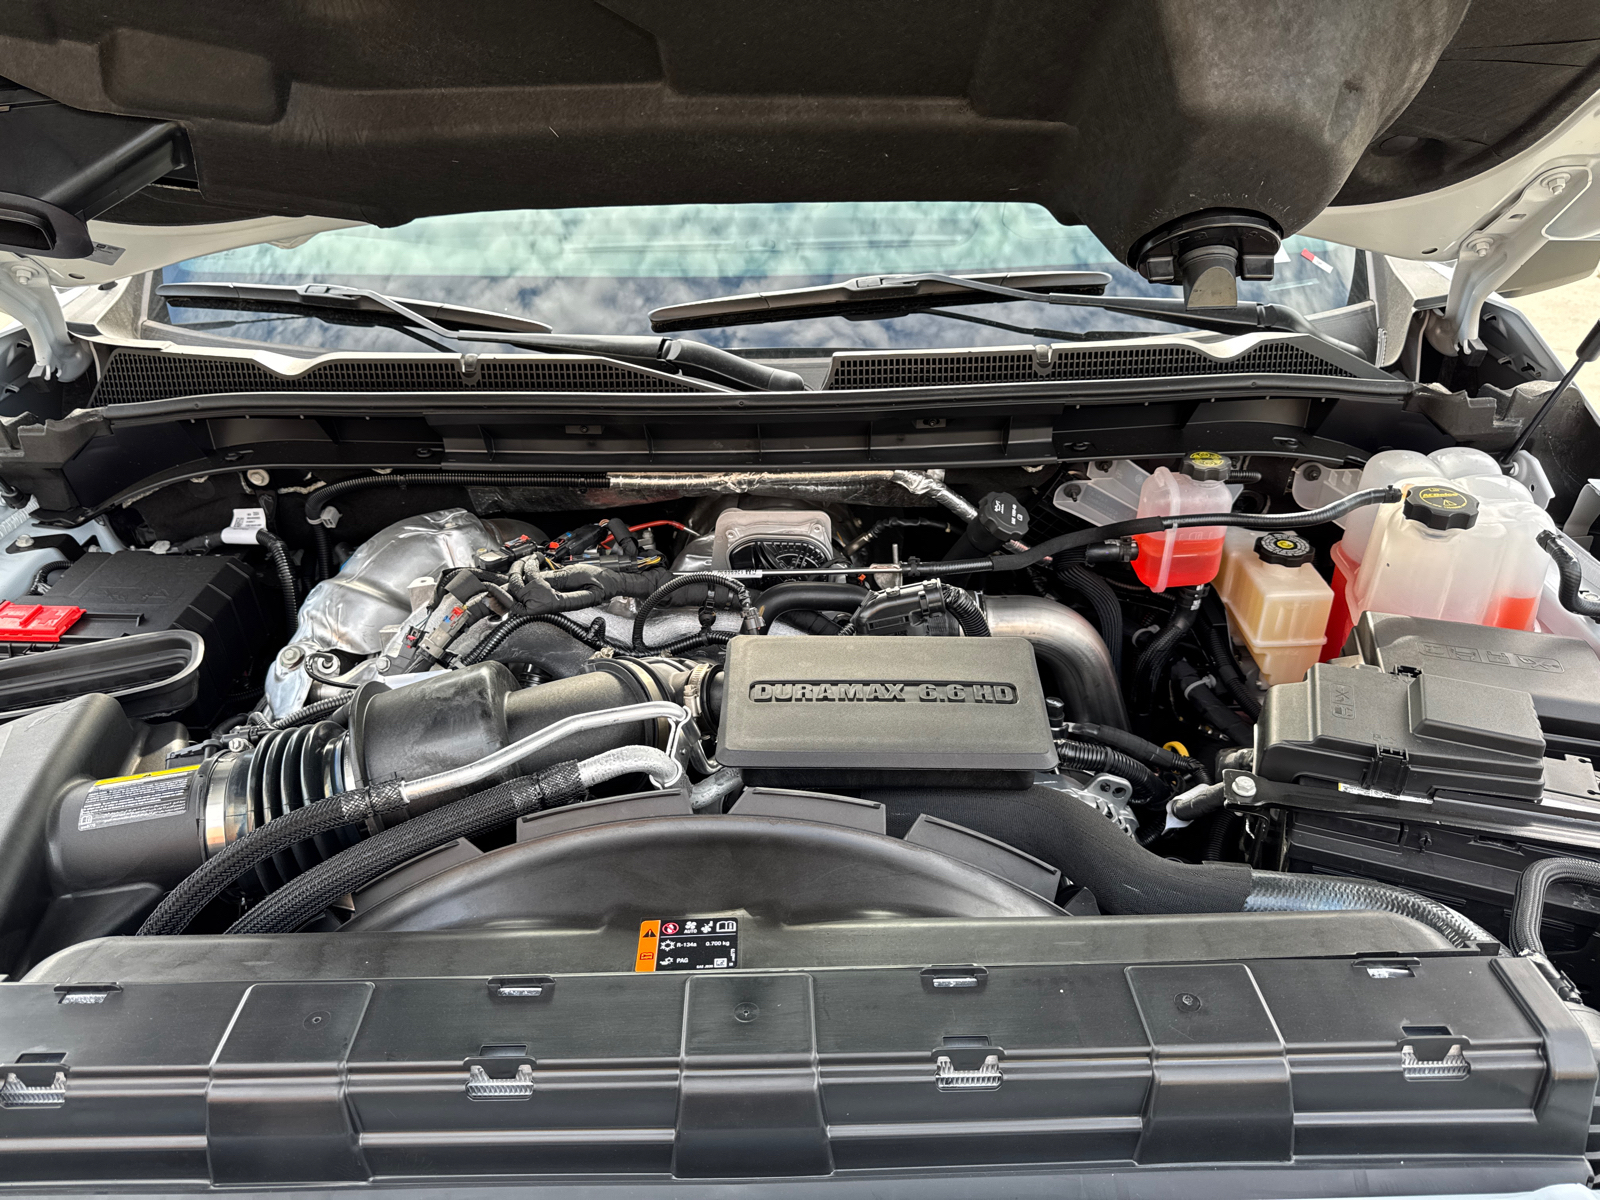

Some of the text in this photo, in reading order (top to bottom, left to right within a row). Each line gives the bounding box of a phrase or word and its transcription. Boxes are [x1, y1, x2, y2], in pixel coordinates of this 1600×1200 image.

[752, 683, 1014, 704] DURAMAX 6.6 HD
